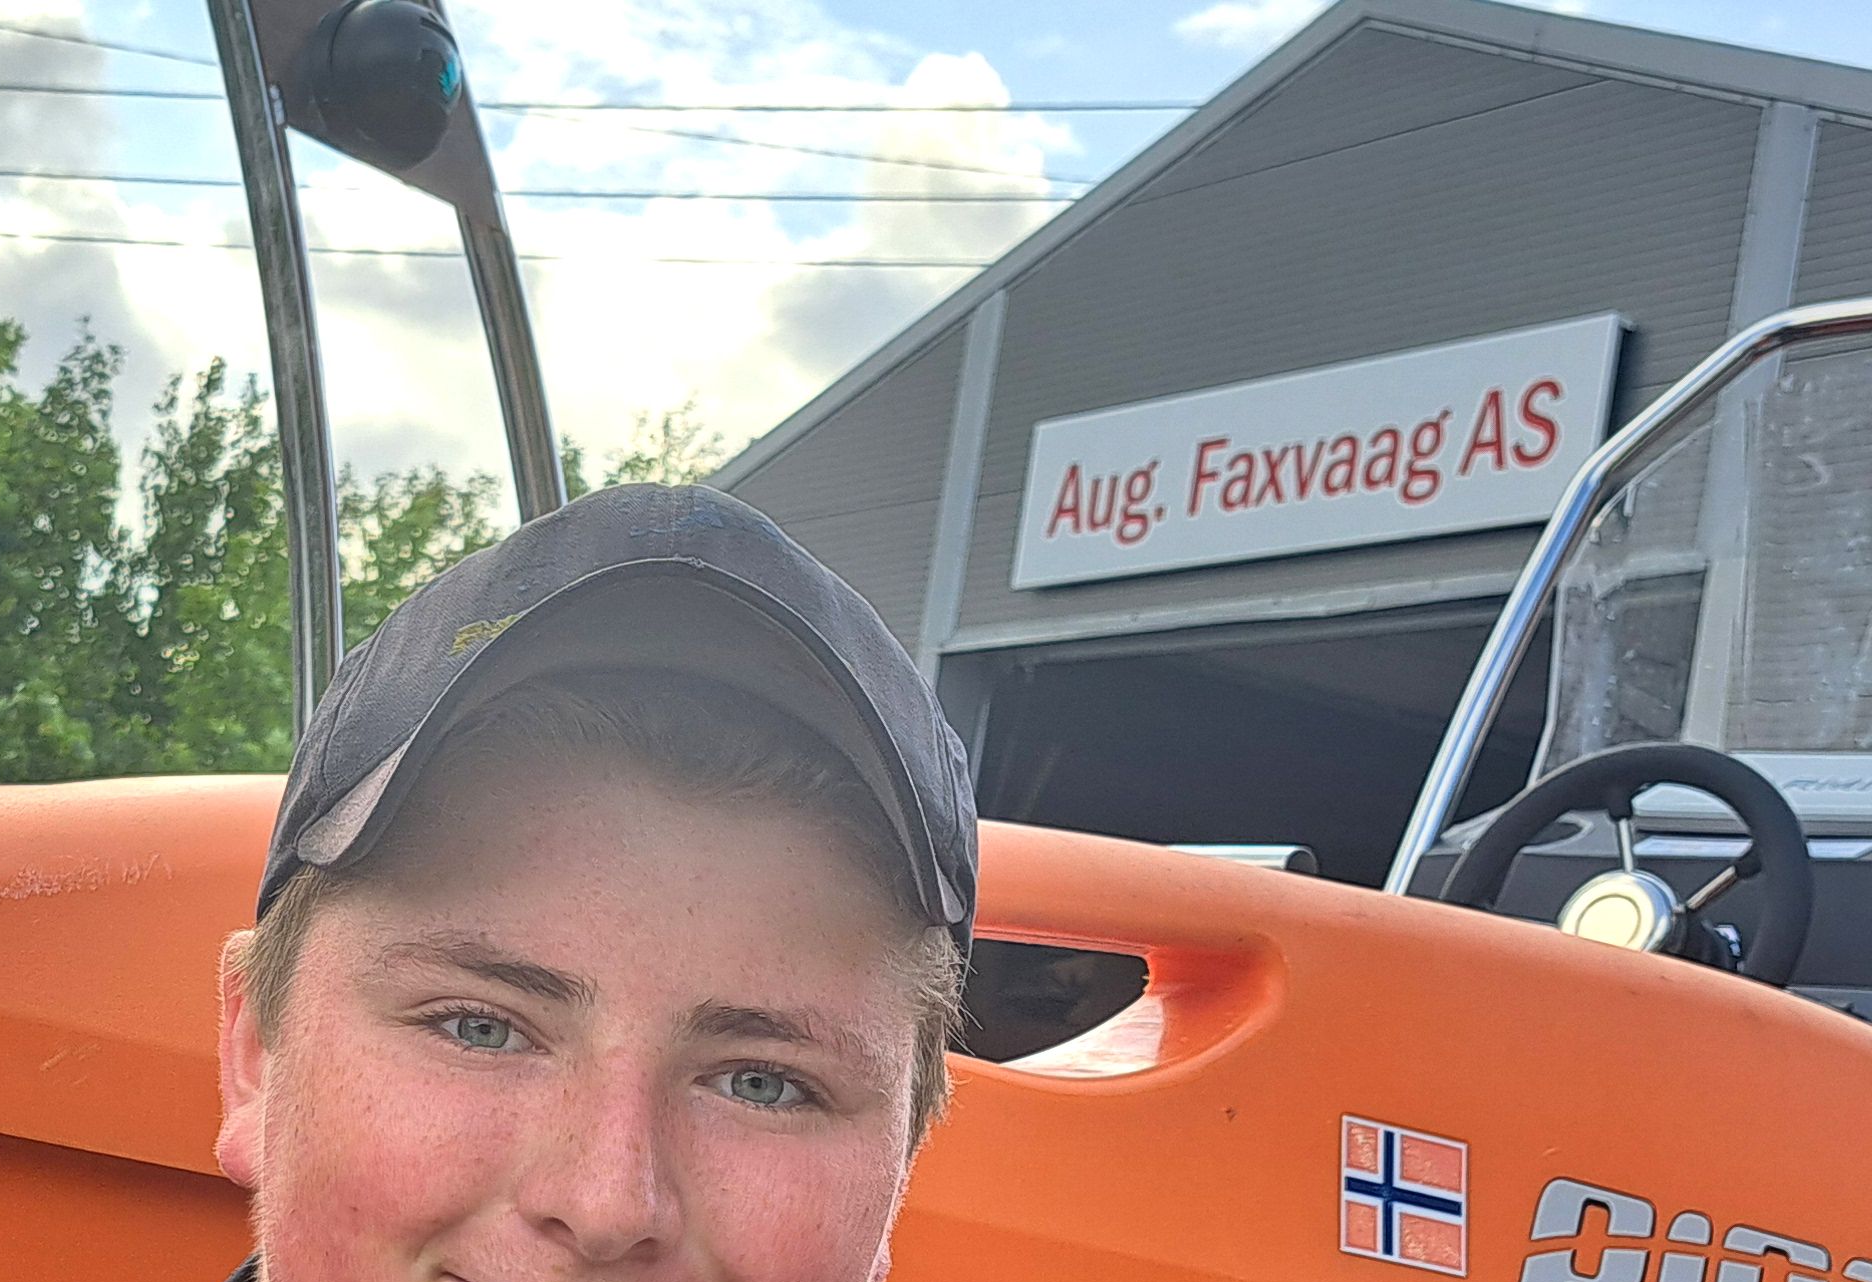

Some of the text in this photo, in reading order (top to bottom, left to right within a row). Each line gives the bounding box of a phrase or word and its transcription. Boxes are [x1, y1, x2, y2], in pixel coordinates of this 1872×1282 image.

[1045, 377, 1564, 547] Aug. Faxvaag AS
